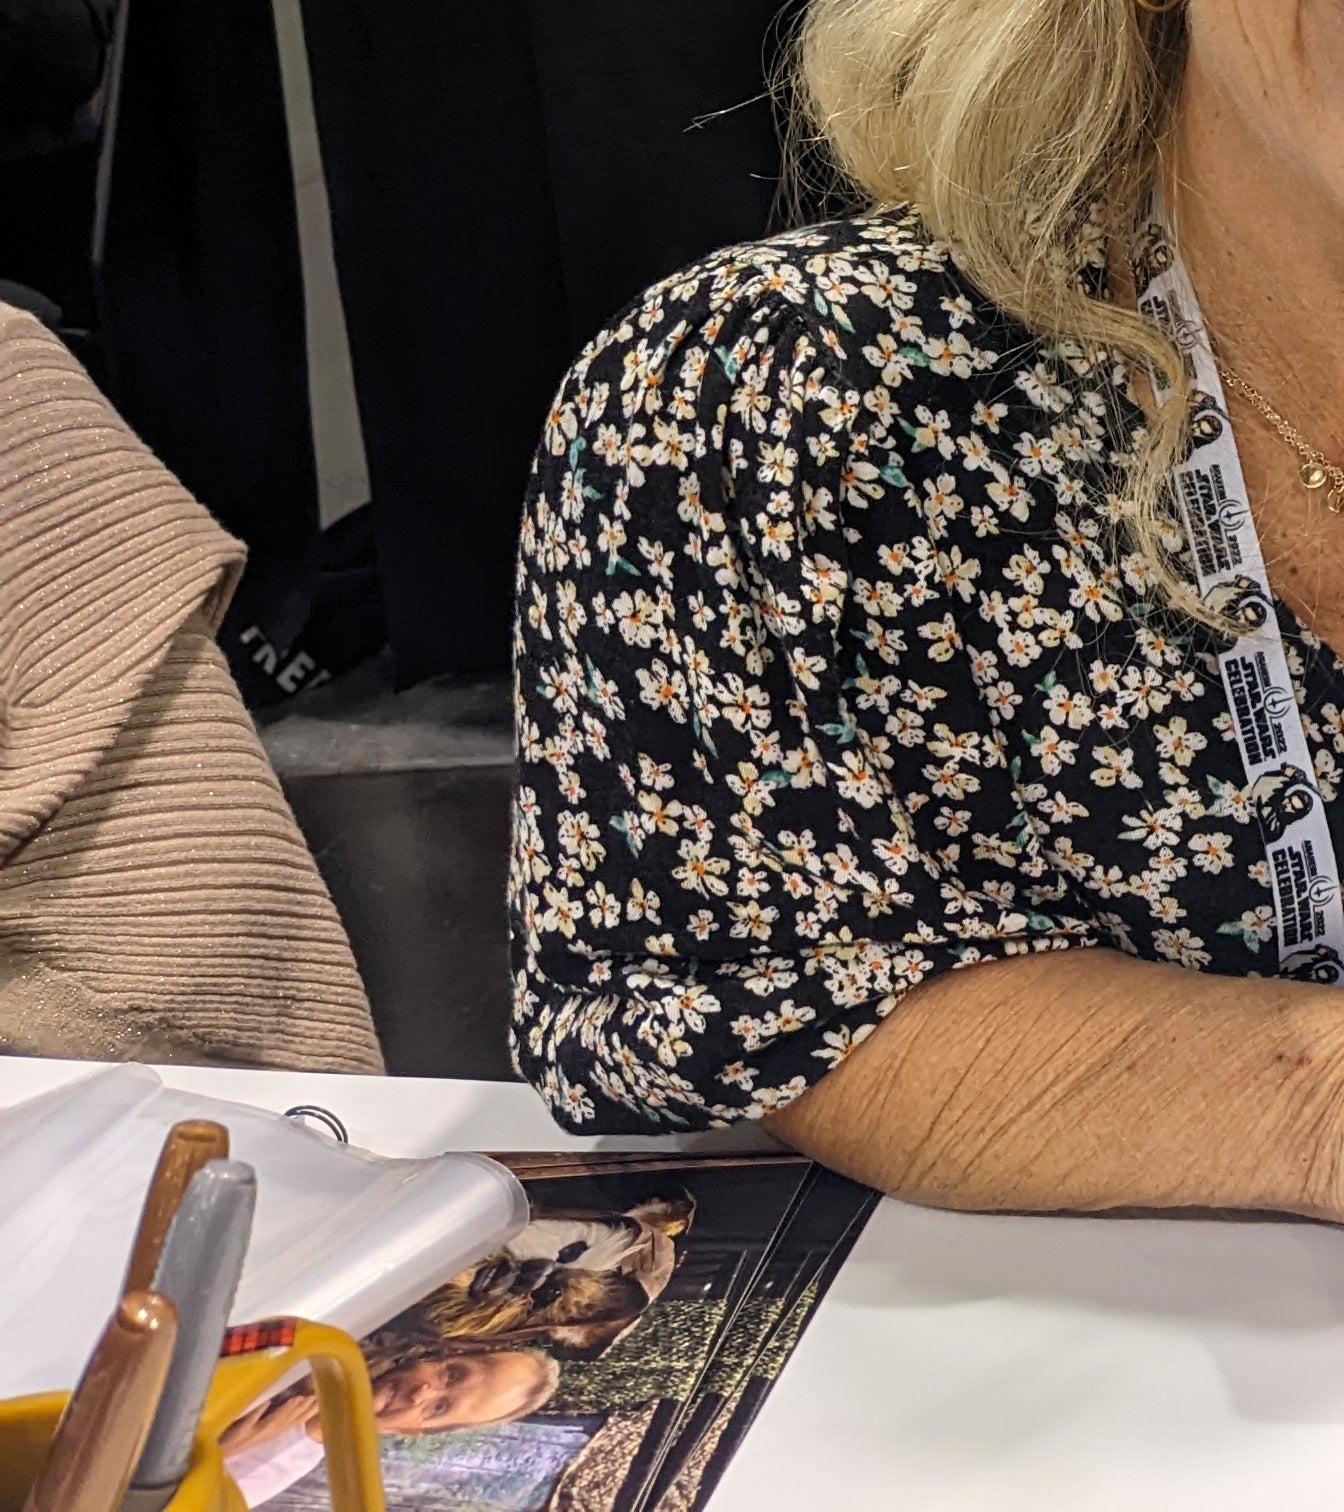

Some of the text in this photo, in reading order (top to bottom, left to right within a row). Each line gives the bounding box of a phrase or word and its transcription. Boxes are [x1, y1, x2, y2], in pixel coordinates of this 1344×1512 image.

[1225, 659, 1263, 766] CELEBRATION
[1240, 656, 1277, 761] STAR WARS
[1273, 722, 1287, 754] 2022
[1272, 849, 1299, 947] CELEBRATION
[1287, 846, 1313, 943] STAR WARS
